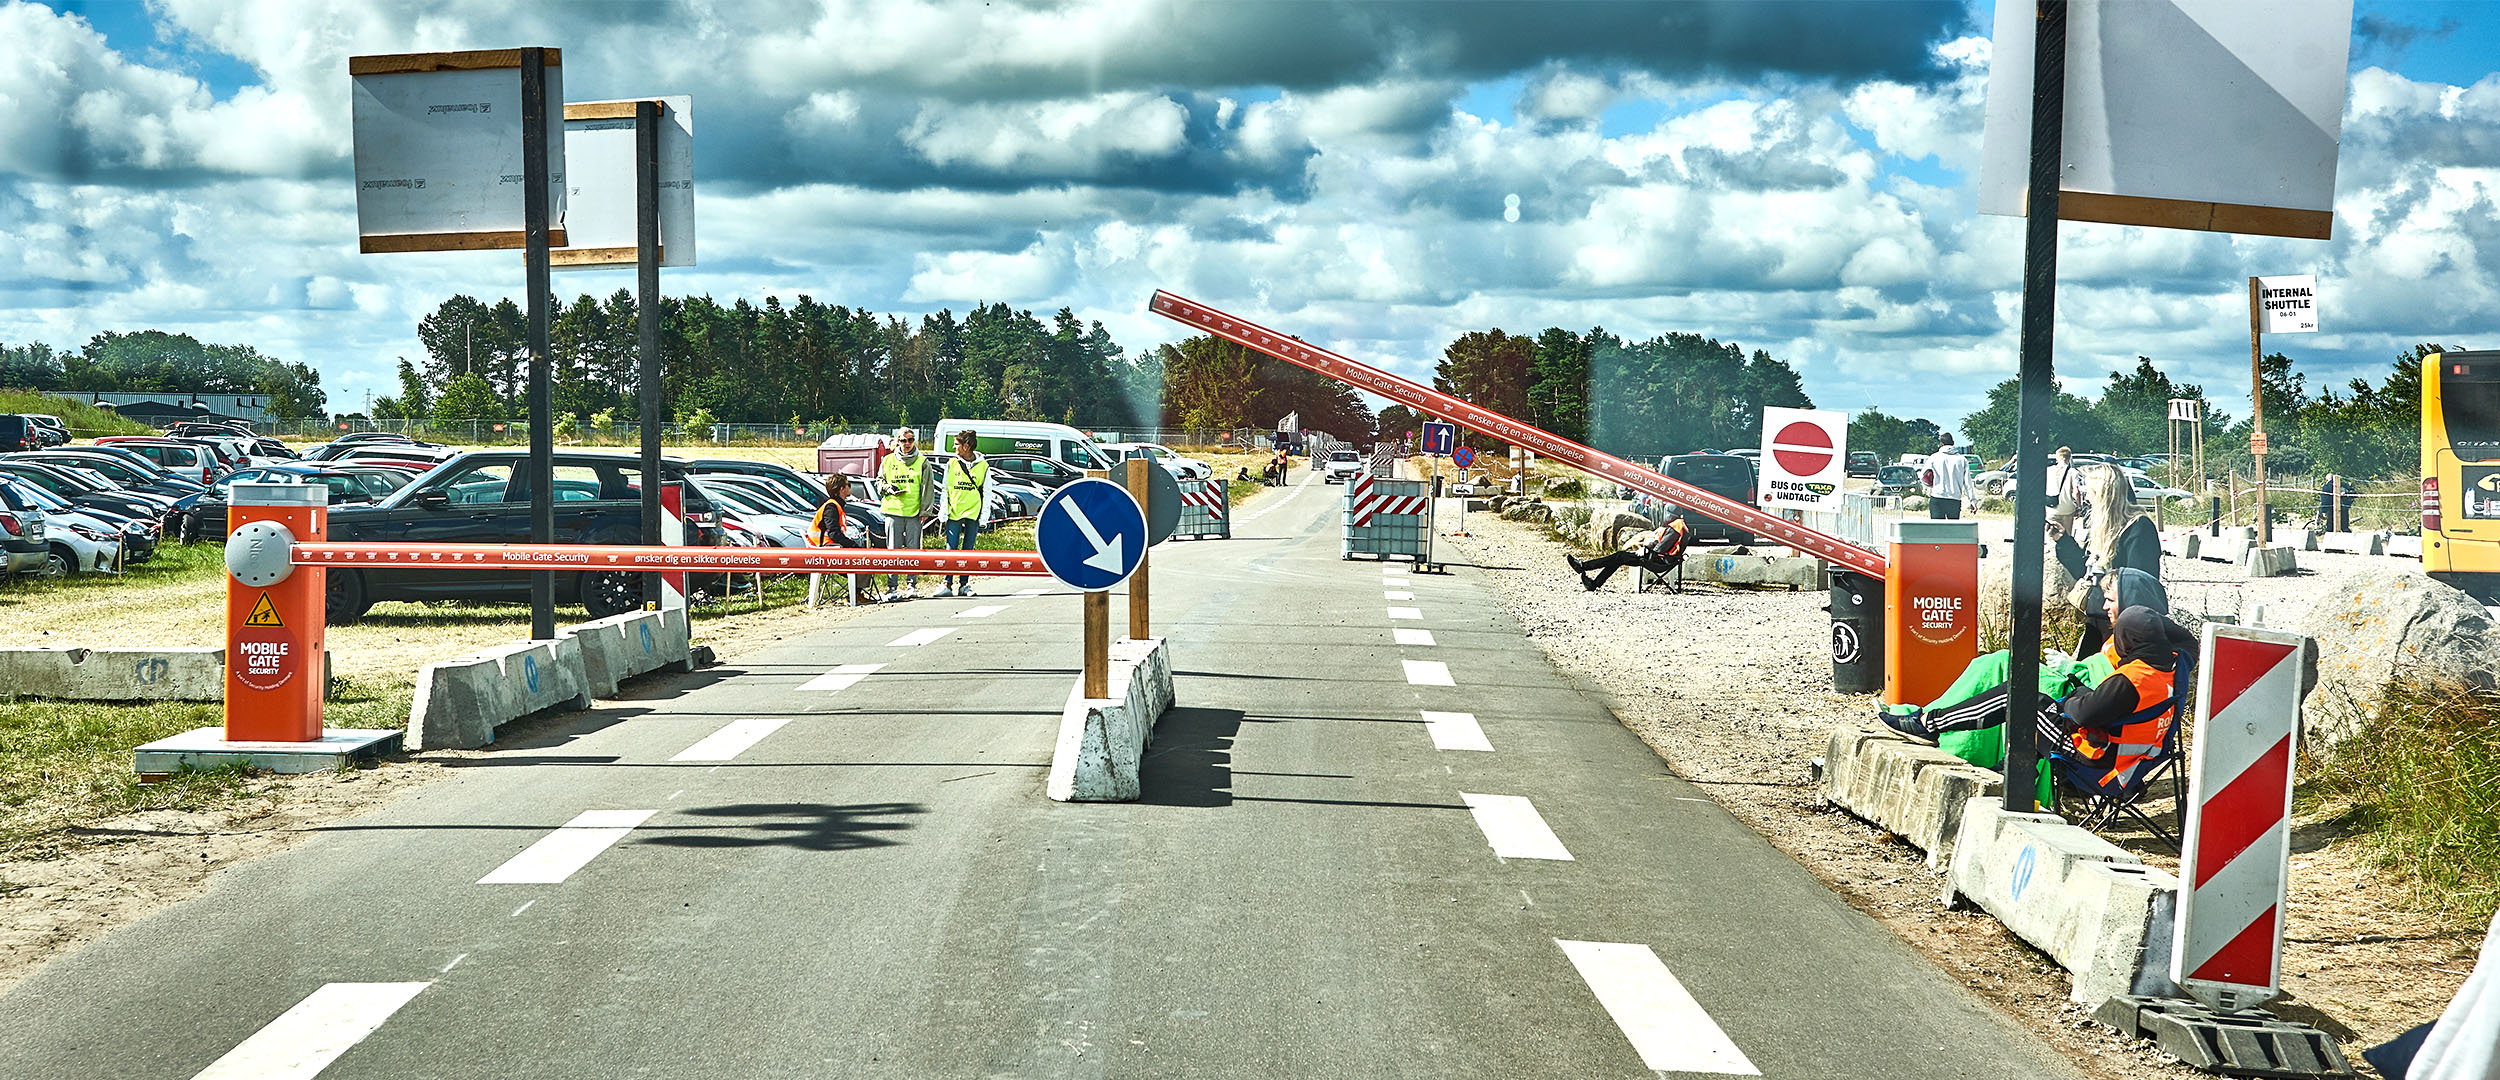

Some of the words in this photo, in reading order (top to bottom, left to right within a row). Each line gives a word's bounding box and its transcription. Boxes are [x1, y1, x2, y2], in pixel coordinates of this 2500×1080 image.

[2262, 287, 2313, 299] INTERNAL
[2264, 299, 2311, 310] SHUTTLE
[1345, 367, 1372, 384] Mobile
[1373, 377, 1393, 391] Gate
[1394, 385, 1427, 404] Security
[1467, 412, 1495, 428] ønsker
[1495, 422, 1509, 434] dig
[1509, 428, 1521, 438] en
[1521, 432, 1546, 447] sikker
[1546, 442, 1585, 461] oplevelse
[1014, 440, 1044, 449] Europcar
[1771, 480, 1789, 490] BUS
[1790, 482, 1804, 492] OG
[1808, 483, 1833, 491] TAXA
[1624, 469, 1643, 482] wish
[1643, 478, 1660, 489] you
[1660, 484, 1666, 492] a
[1667, 486, 1685, 499] safe
[1685, 493, 1730, 516] experience
[1777, 491, 1821, 502] UNDTAGET
[502, 551, 531, 561] Mobile
[532, 551, 552, 561] Gate
[554, 552, 590, 564] Security
[634, 554, 663, 563] ønsker
[664, 554, 679, 565] dig
[693, 555, 719, 564] sikker
[720, 556, 761, 565] oplevelse
[804, 555, 825, 565] wish
[826, 558, 843, 567] you
[852, 556, 870, 566] safe
[872, 557, 920, 567] experience
[1913, 596, 1962, 609] MOBILE
[1921, 610, 1953, 621] GATE
[1921, 621, 1953, 629] SECURITY
[240, 641, 289, 656] MOBILE
[248, 655, 280, 667] GATE
[248, 667, 280, 675] SECURITY
